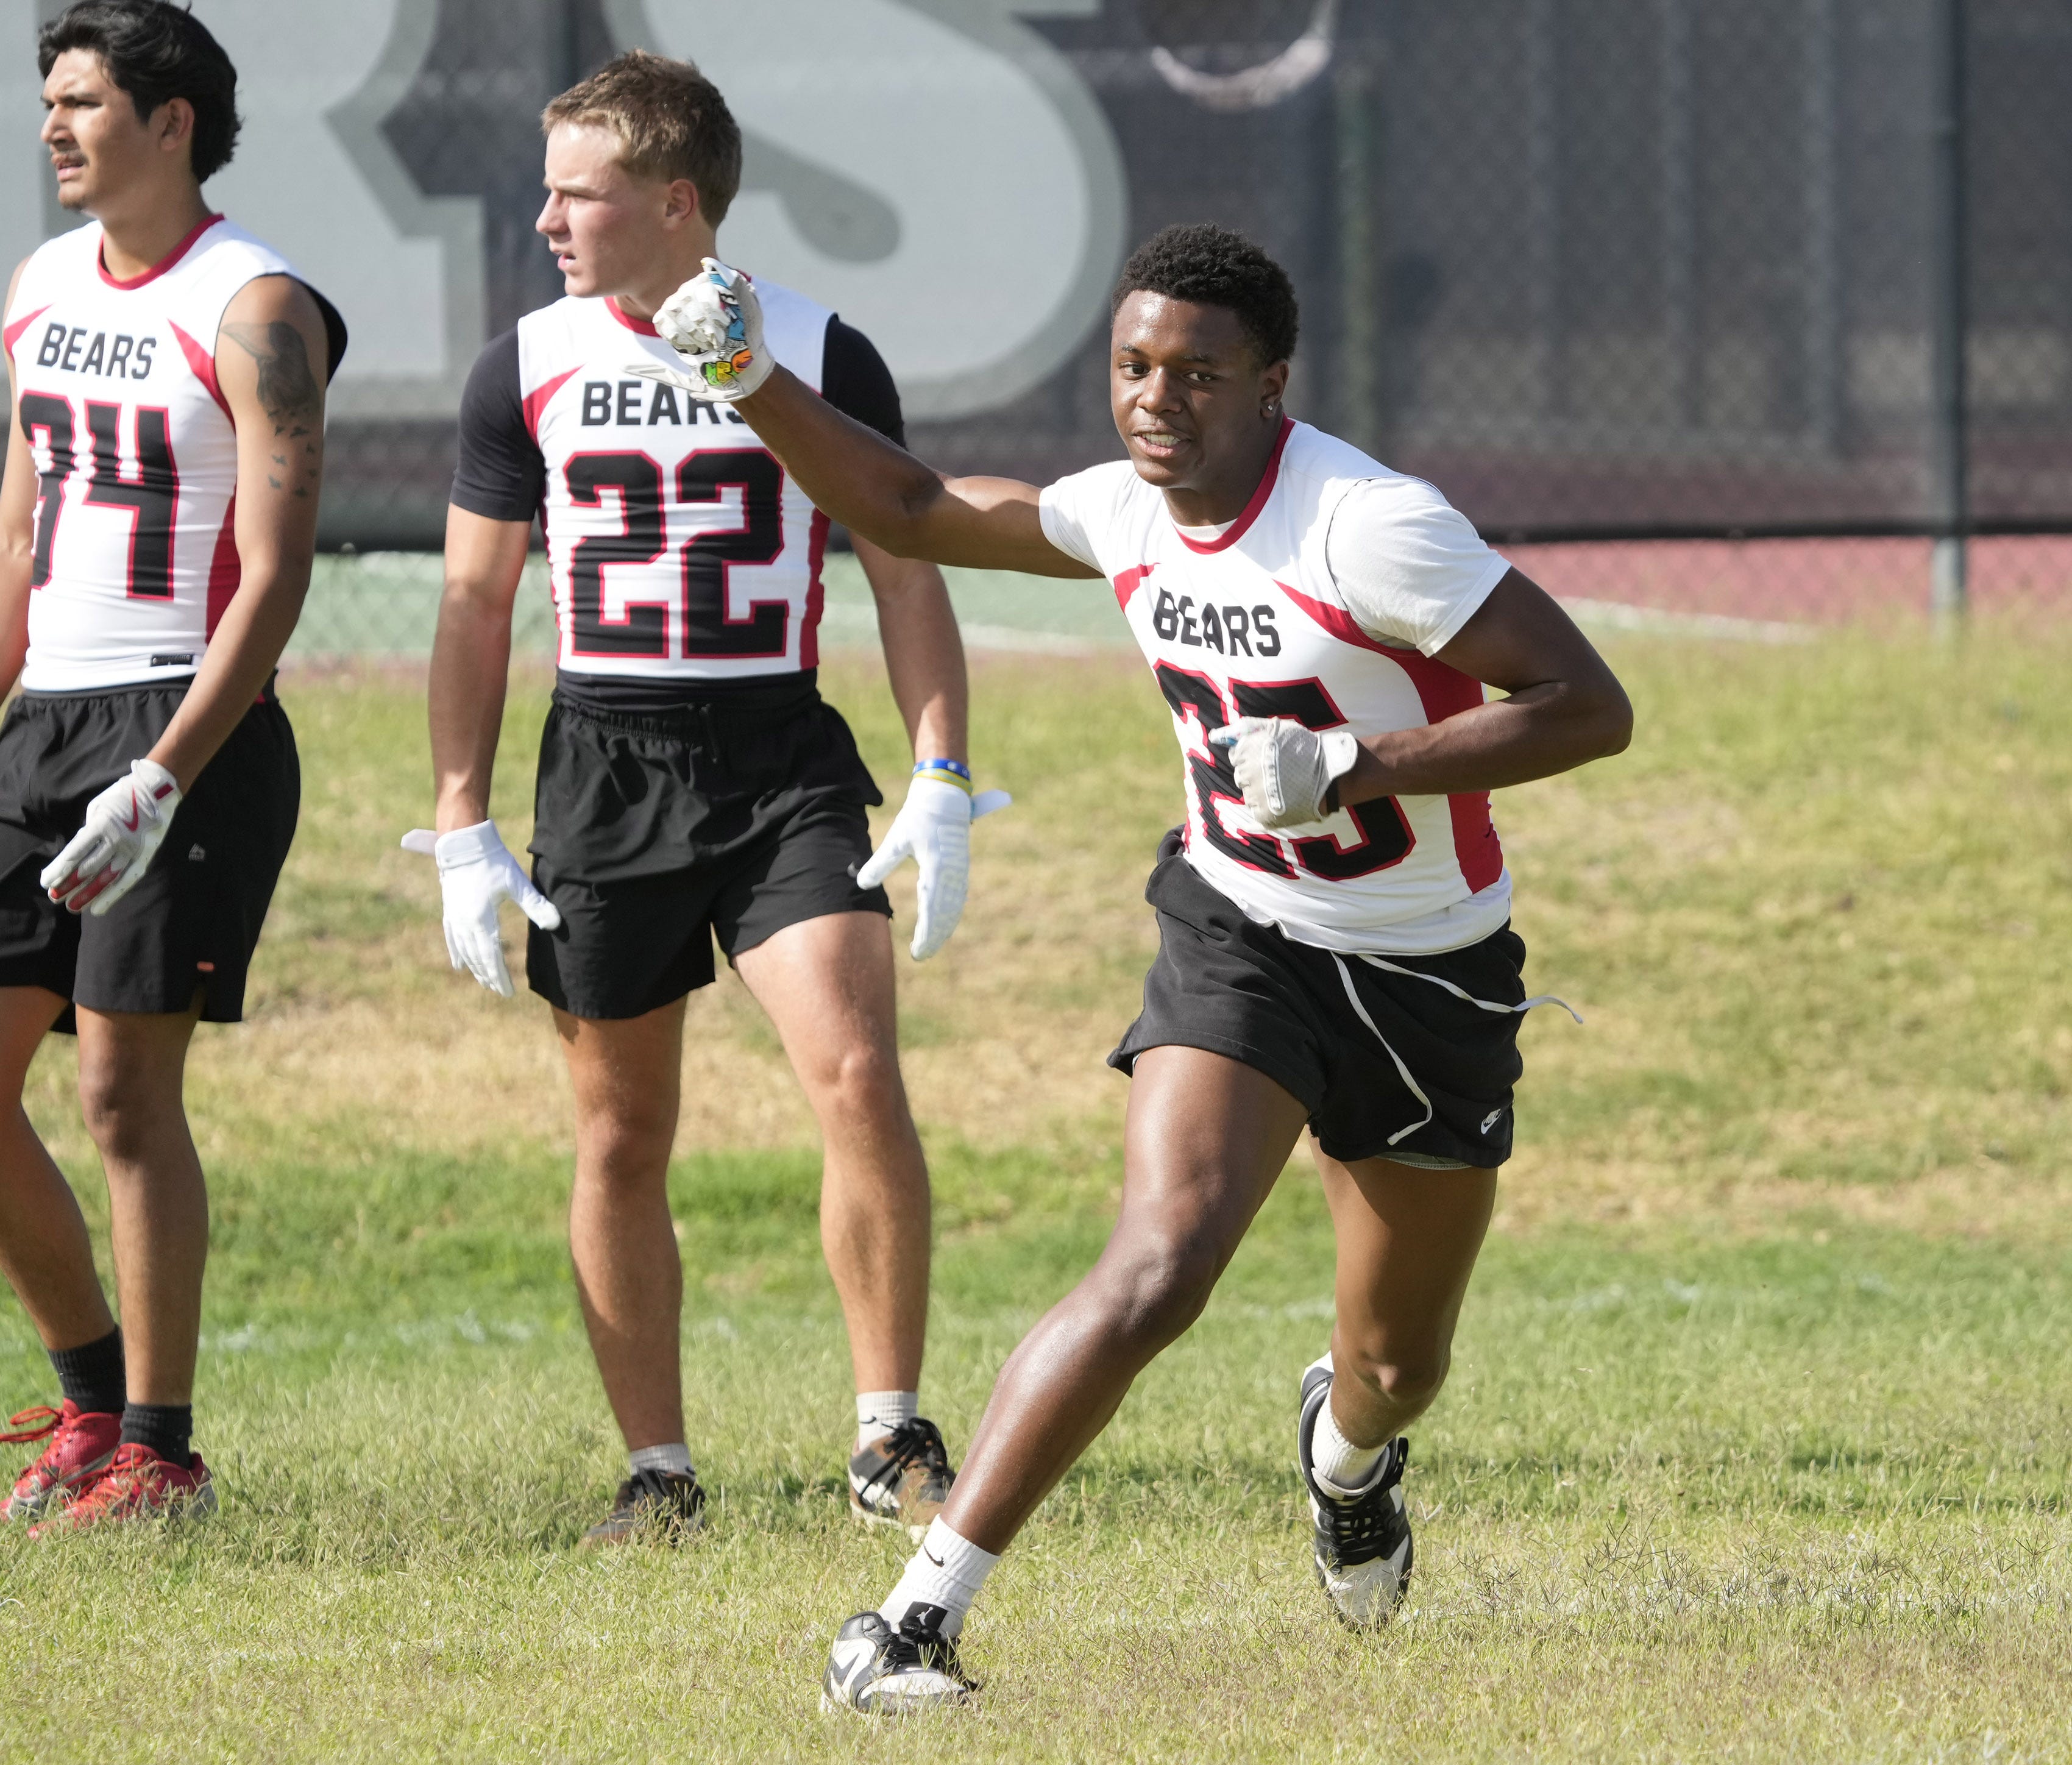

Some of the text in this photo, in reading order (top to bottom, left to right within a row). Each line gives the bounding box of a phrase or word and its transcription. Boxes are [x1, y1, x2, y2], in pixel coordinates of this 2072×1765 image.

[37, 321, 157, 380] BEARS
[581, 380, 747, 426] BEAR
[18, 389, 180, 602] 34
[563, 448, 789, 659] 22
[1152, 586, 1282, 658] BEARS
[1152, 658, 1417, 882] 25
